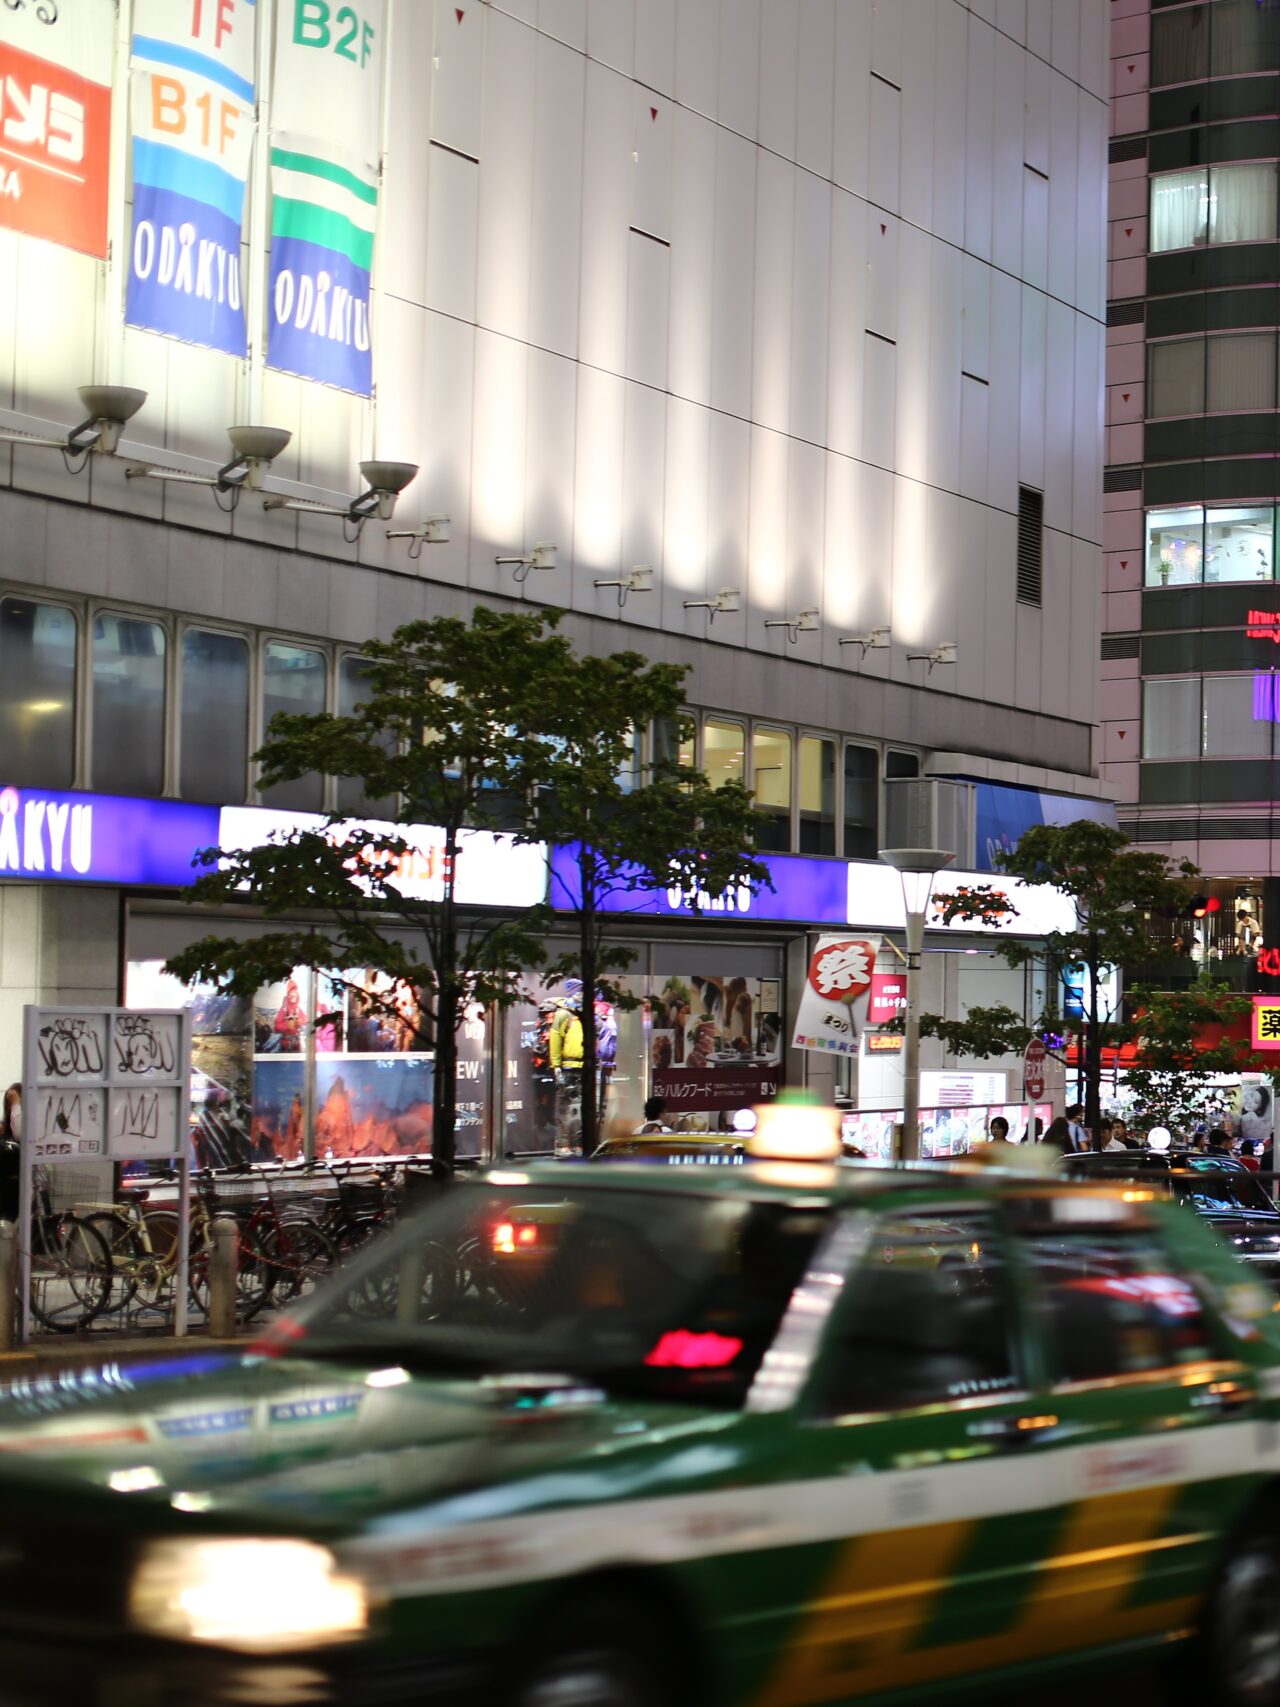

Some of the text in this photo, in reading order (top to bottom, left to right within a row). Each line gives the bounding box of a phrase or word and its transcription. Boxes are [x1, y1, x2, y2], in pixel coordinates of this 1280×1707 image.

[292, 0, 375, 70] B2F
[150, 74, 241, 155] B1F
[133, 219, 241, 312] ODAKYU
[274, 268, 370, 352] ODAKYU
[815, 945, 872, 994] 祭
[824, 1015, 849, 1032] まつり
[665, 1082, 713, 1098] ハルクフード
